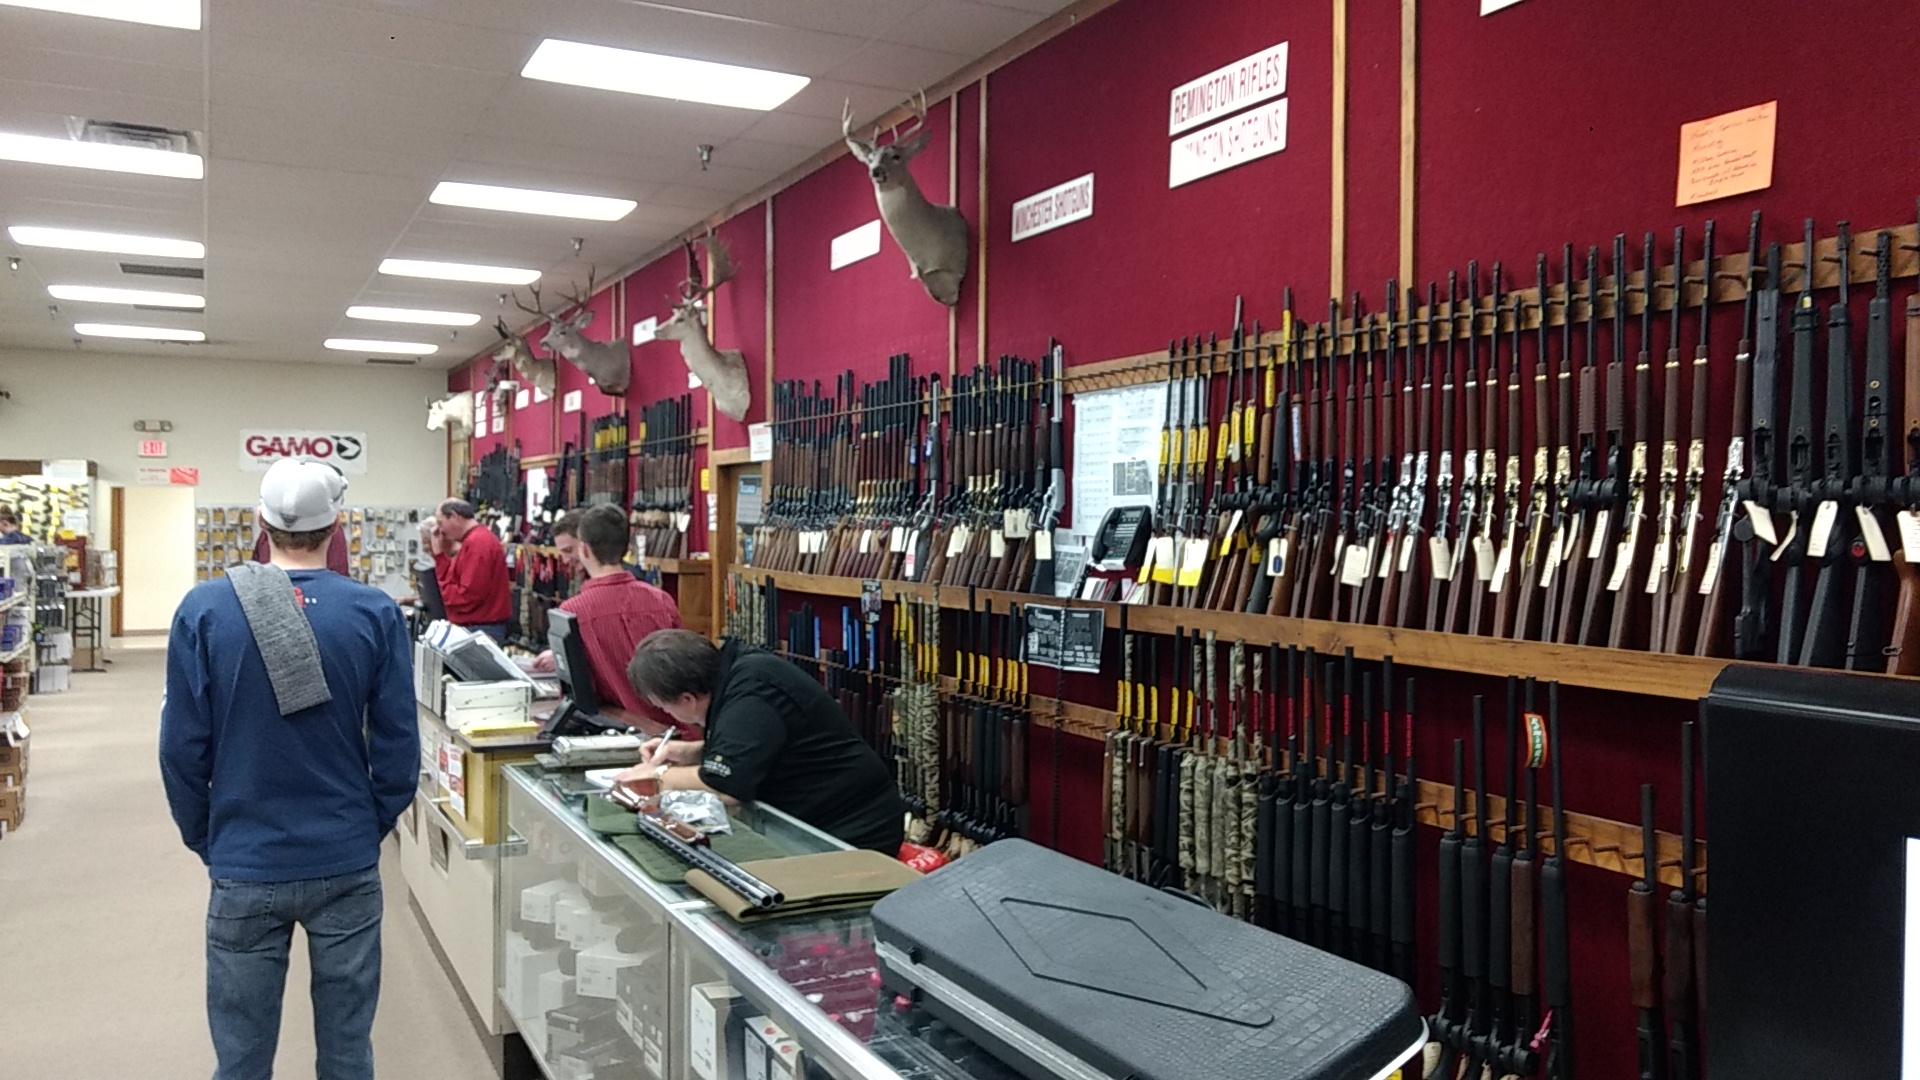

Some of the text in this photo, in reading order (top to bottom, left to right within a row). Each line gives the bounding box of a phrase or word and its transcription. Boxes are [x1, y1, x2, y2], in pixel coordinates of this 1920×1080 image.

[1173, 52, 1281, 126] REMINGTON RIFLES
[1228, 108, 1280, 158] SHOTGUNS
[1014, 180, 1090, 235] WINCHESTER SHOTGUNS
[143, 441, 163, 455] EXIT
[245, 435, 334, 458] GAMO
